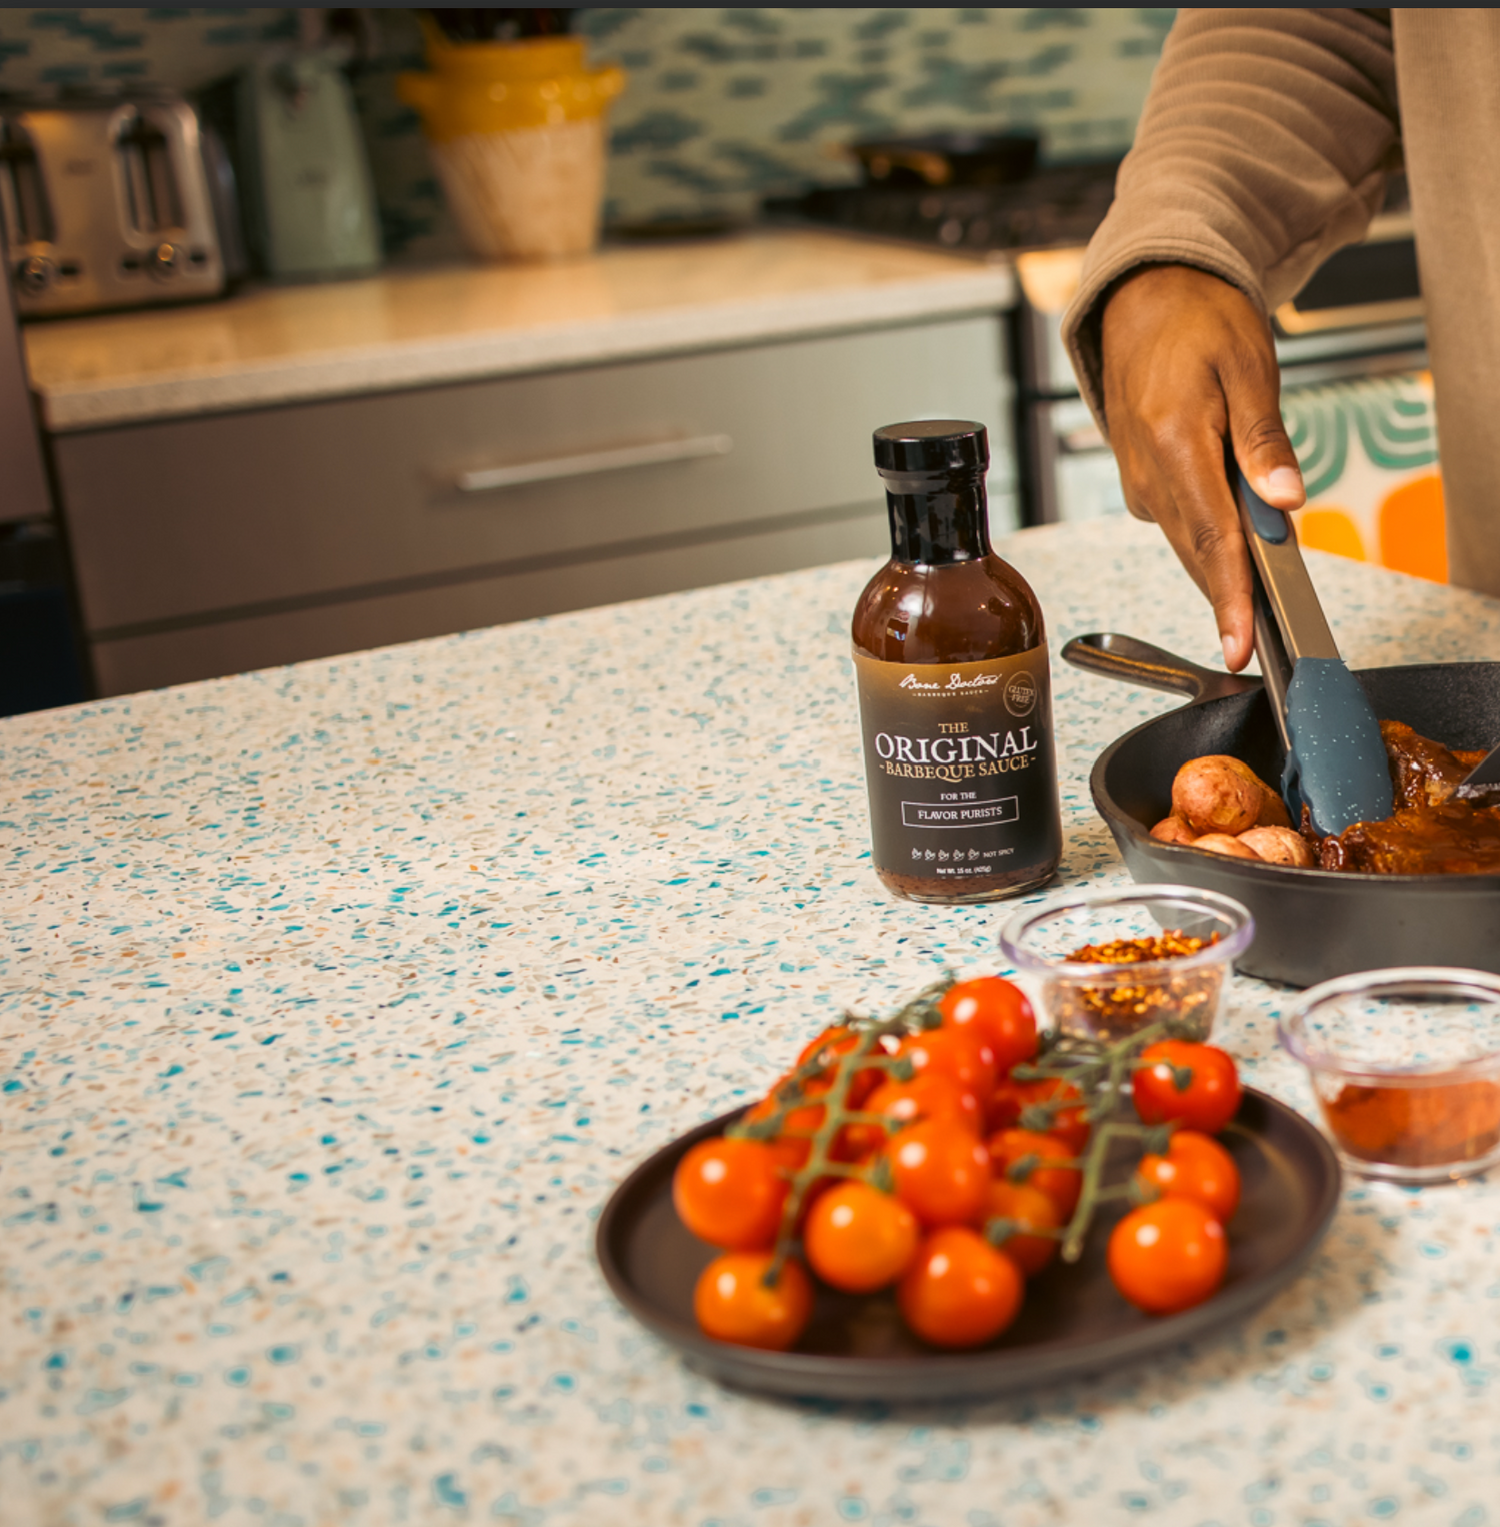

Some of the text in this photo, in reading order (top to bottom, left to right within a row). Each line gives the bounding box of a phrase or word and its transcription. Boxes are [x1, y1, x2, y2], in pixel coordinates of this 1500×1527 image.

[898, 673, 941, 690] Bone
[1008, 685, 1035, 696] GLUTEN
[1011, 693, 1031, 704] FREE
[938, 722, 970, 734] THE
[875, 726, 1038, 763] ORIGINAL
[940, 791, 977, 801] FOR THE
[918, 806, 1003, 821] FLAVOR PURISTS
[983, 847, 1015, 858] NOT SPICY
